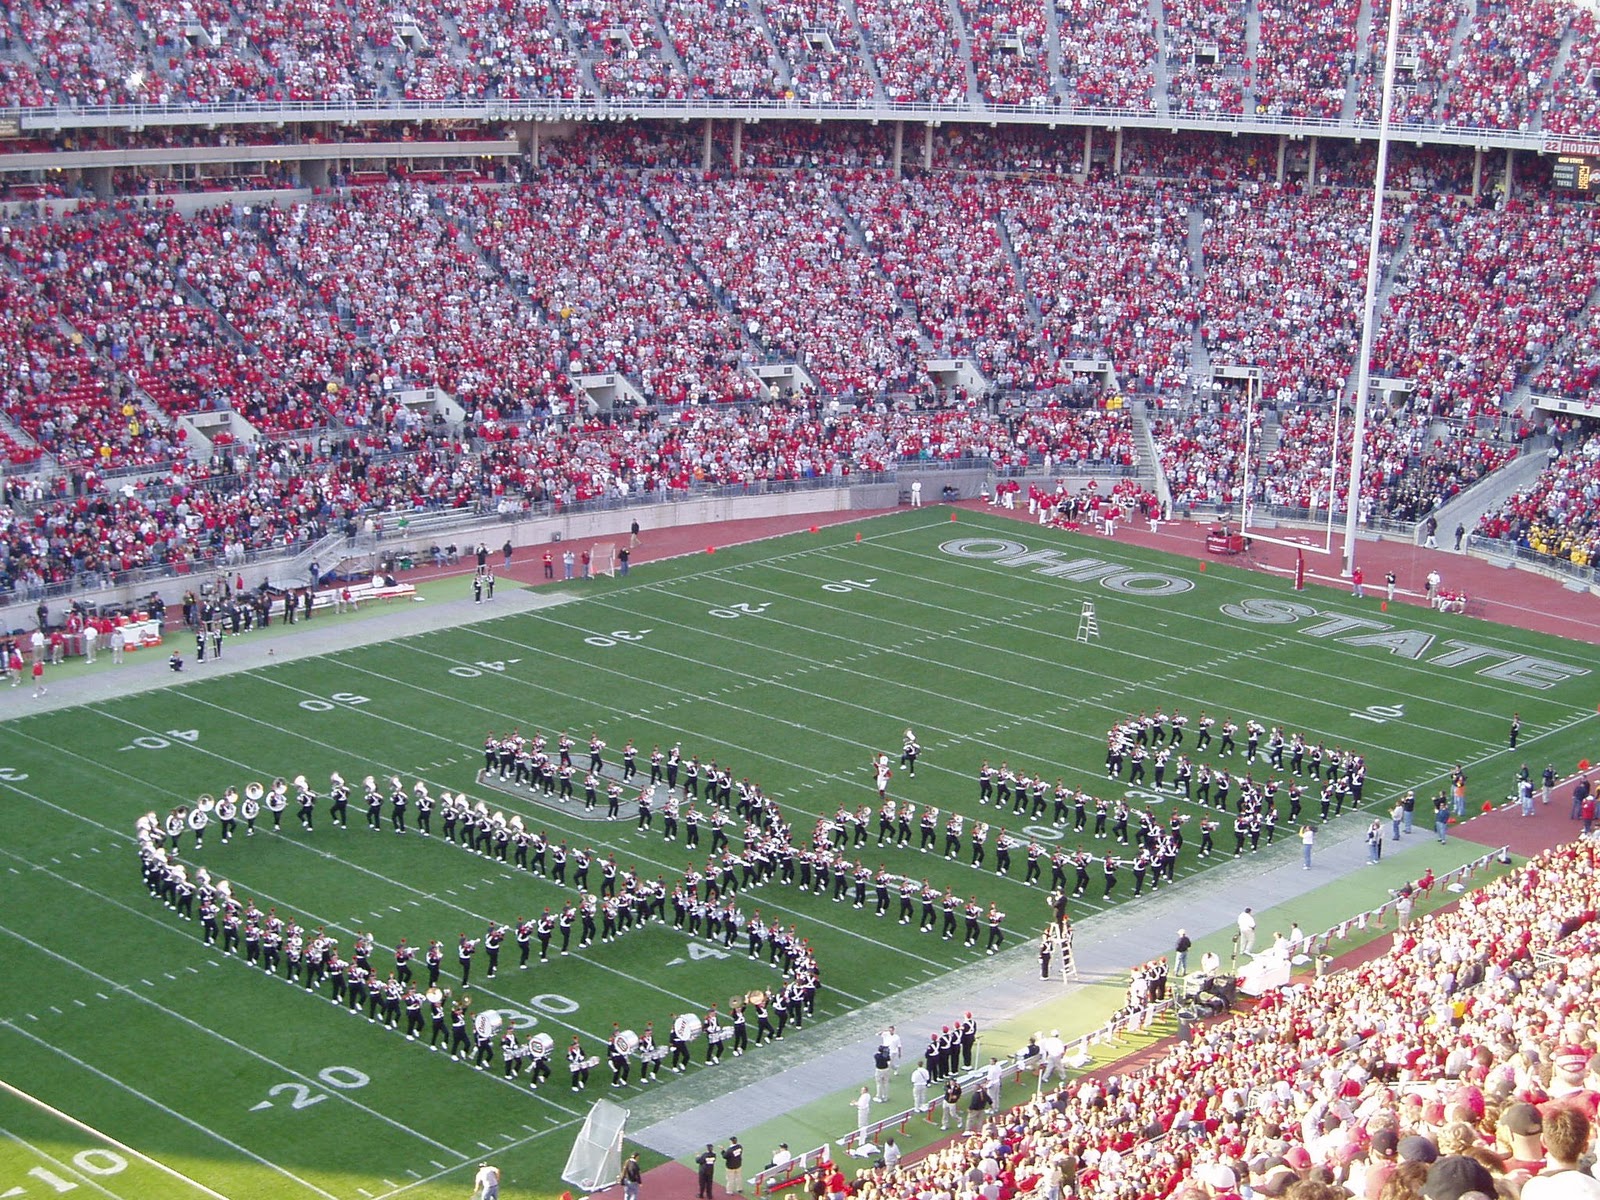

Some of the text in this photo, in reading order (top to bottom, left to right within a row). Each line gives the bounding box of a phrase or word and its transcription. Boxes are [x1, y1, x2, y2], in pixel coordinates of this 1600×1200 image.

[1544, 142, 1559, 151] 22
[938, 537, 1196, 596] OHIO
[822, 578, 873, 593] 10
[708, 602, 766, 619] 20
[584, 629, 645, 647] 30
[1219, 598, 1592, 689] STATE
[448, 659, 507, 678] 40
[299, 693, 371, 712] 50
[1349, 706, 1403, 723] 10
[132, 728, 199, 750] 40
[496, 993, 580, 1029] 30
[267, 1065, 371, 1110] 20
[27, 1148, 128, 1193] 10
